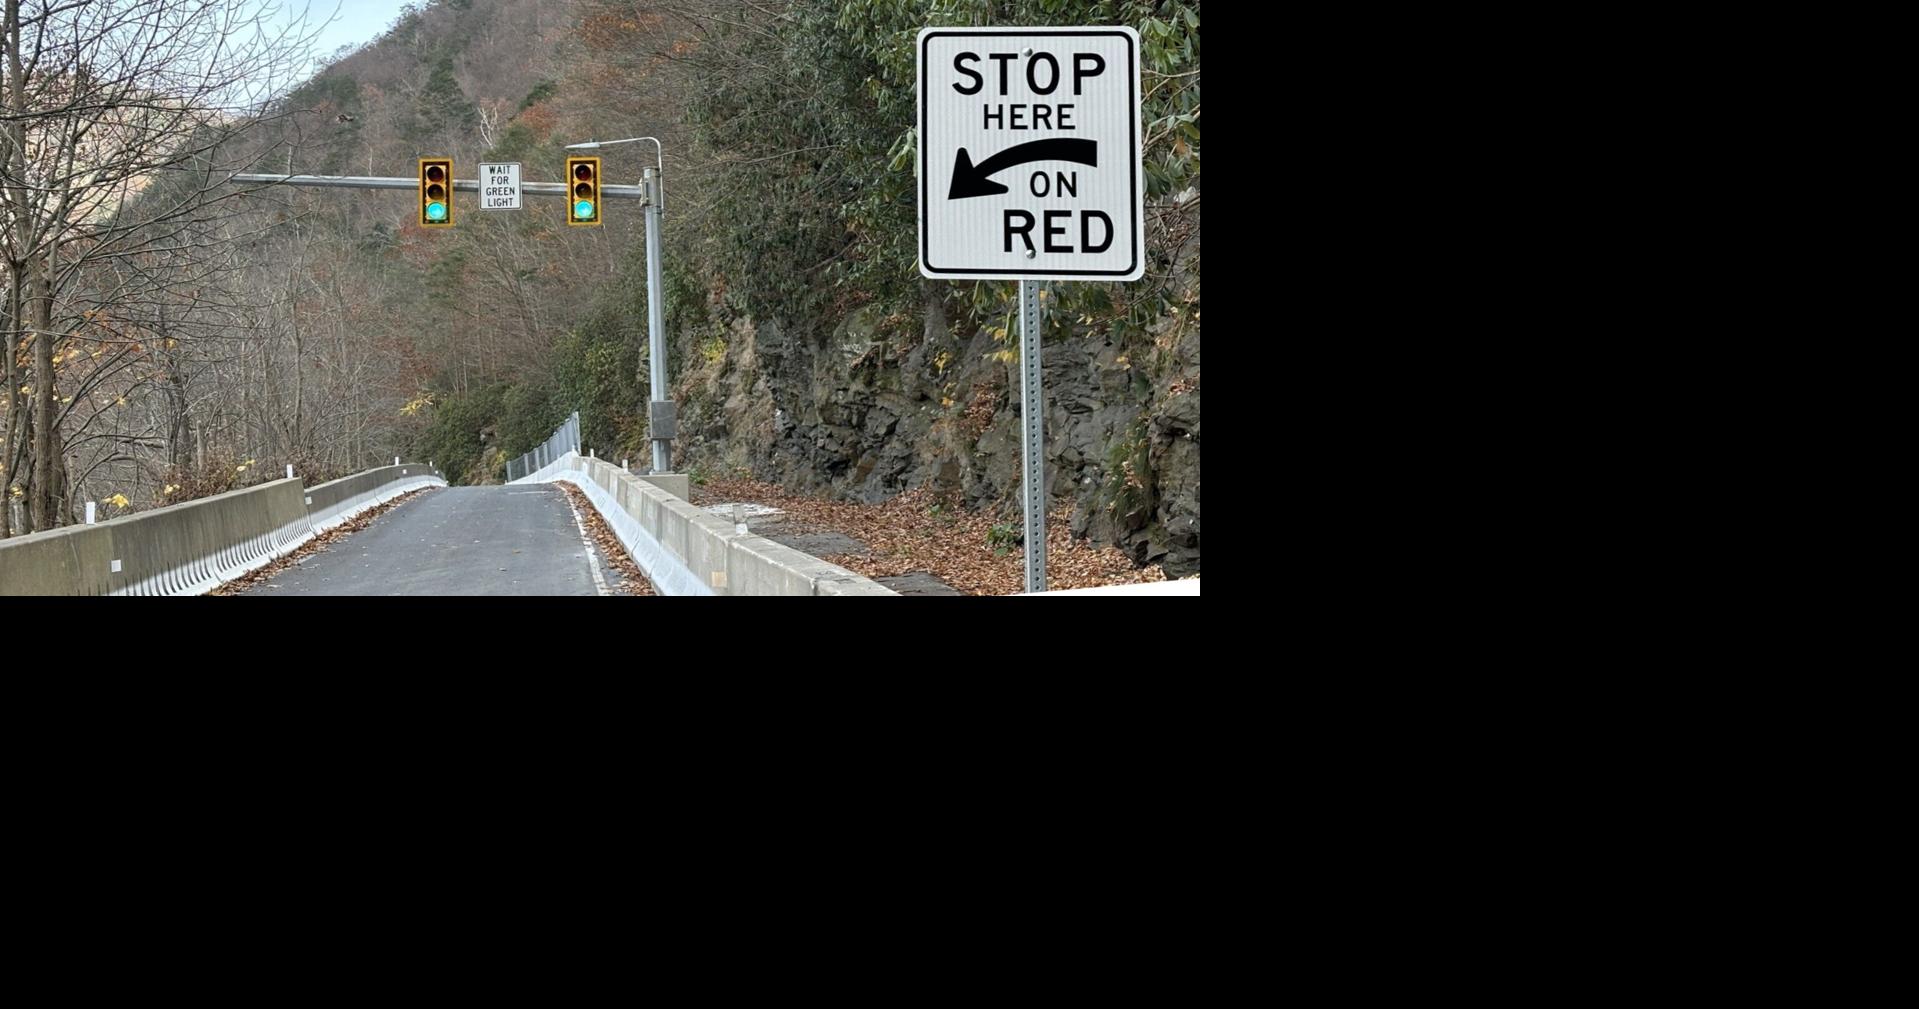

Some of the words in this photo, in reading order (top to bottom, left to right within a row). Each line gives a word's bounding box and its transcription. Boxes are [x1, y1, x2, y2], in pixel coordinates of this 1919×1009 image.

[952, 51, 1106, 96] STOP
[984, 103, 1076, 130] HERE
[488, 165, 512, 175] WAIT
[491, 175, 509, 185] FOR
[1030, 170, 1077, 198] ON
[485, 186, 515, 196] GREEN
[487, 197, 513, 207] LIGHT
[1003, 209, 1114, 254] RED
